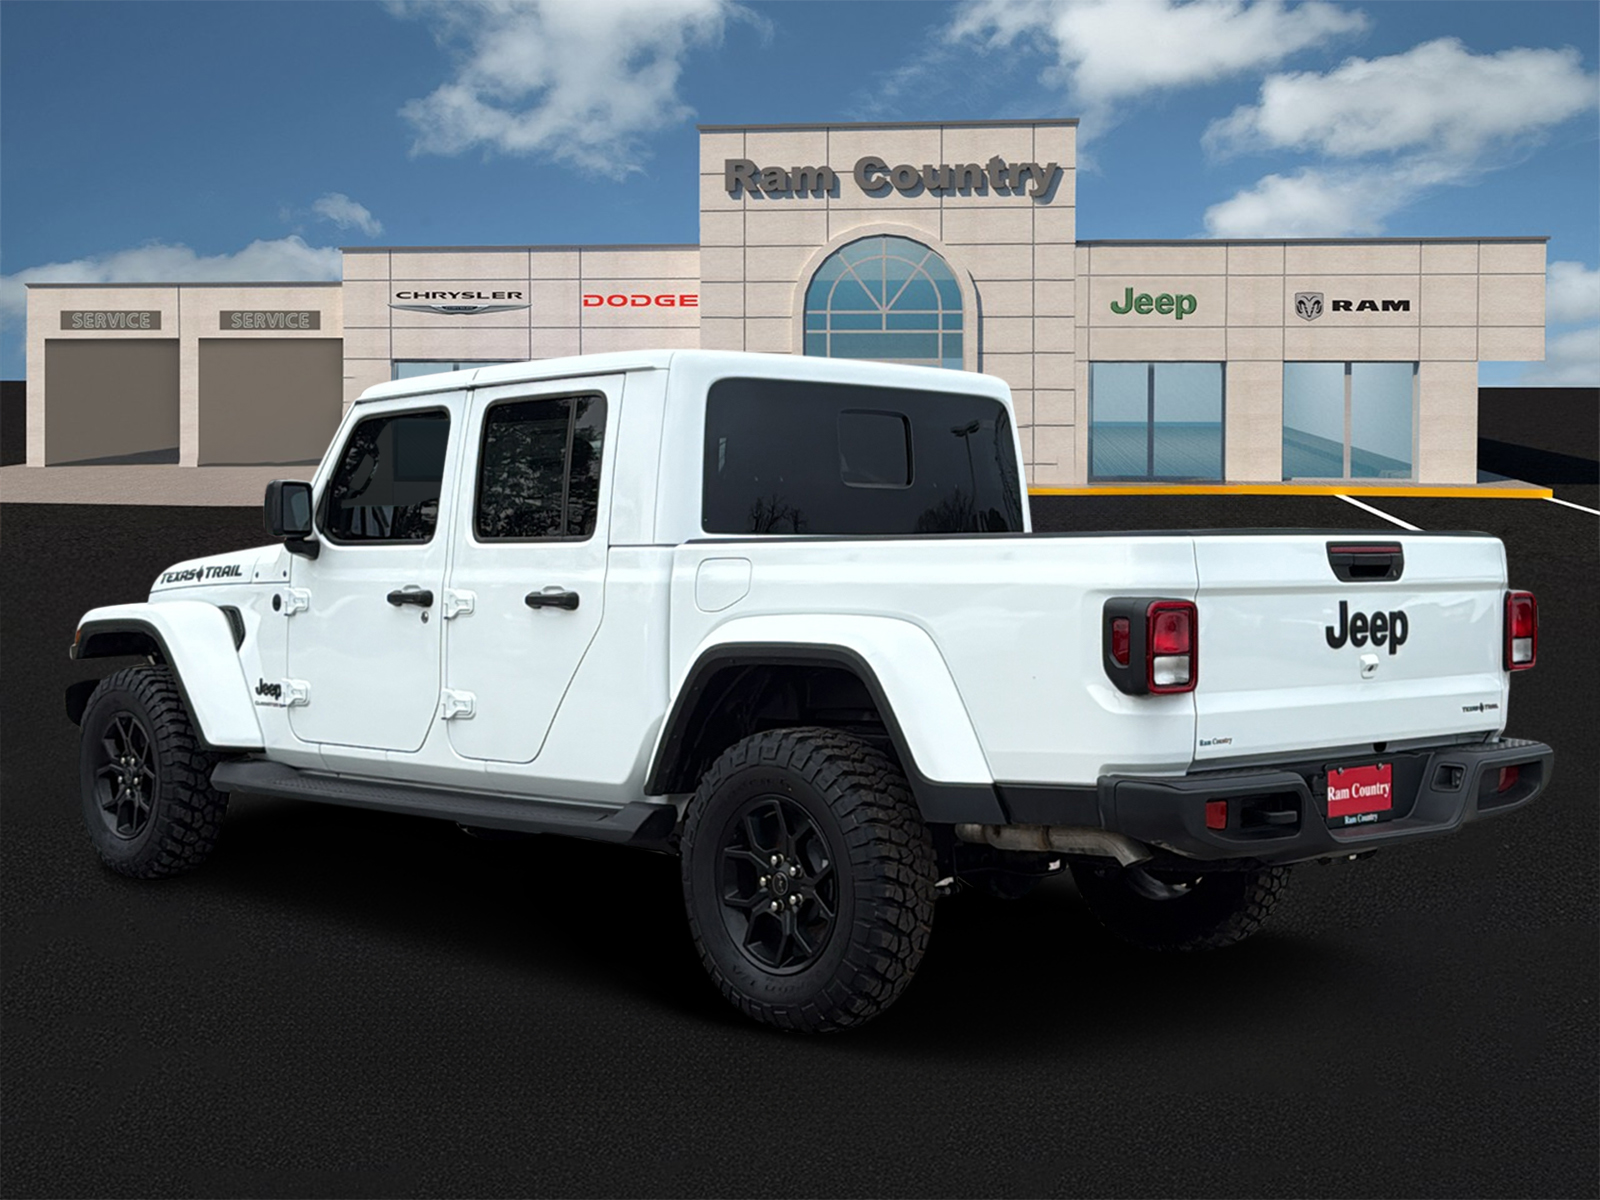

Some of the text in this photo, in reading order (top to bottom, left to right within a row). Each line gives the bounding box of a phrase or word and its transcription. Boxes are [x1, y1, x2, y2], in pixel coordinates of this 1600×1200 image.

[724, 154, 1057, 198] Ram Country
[395, 291, 523, 300] CHRYSLER
[583, 294, 699, 307] DODGE
[1110, 287, 1197, 320] Jeep
[1332, 299, 1410, 312] RAM
[71, 312, 151, 329] SERVICE
[231, 312, 310, 329] SERVICE
[160, 564, 242, 585] TEXAS TRAIL
[1325, 600, 1409, 655] Jeep
[255, 678, 282, 701] Jeep
[1327, 782, 1391, 801] Ram Country
